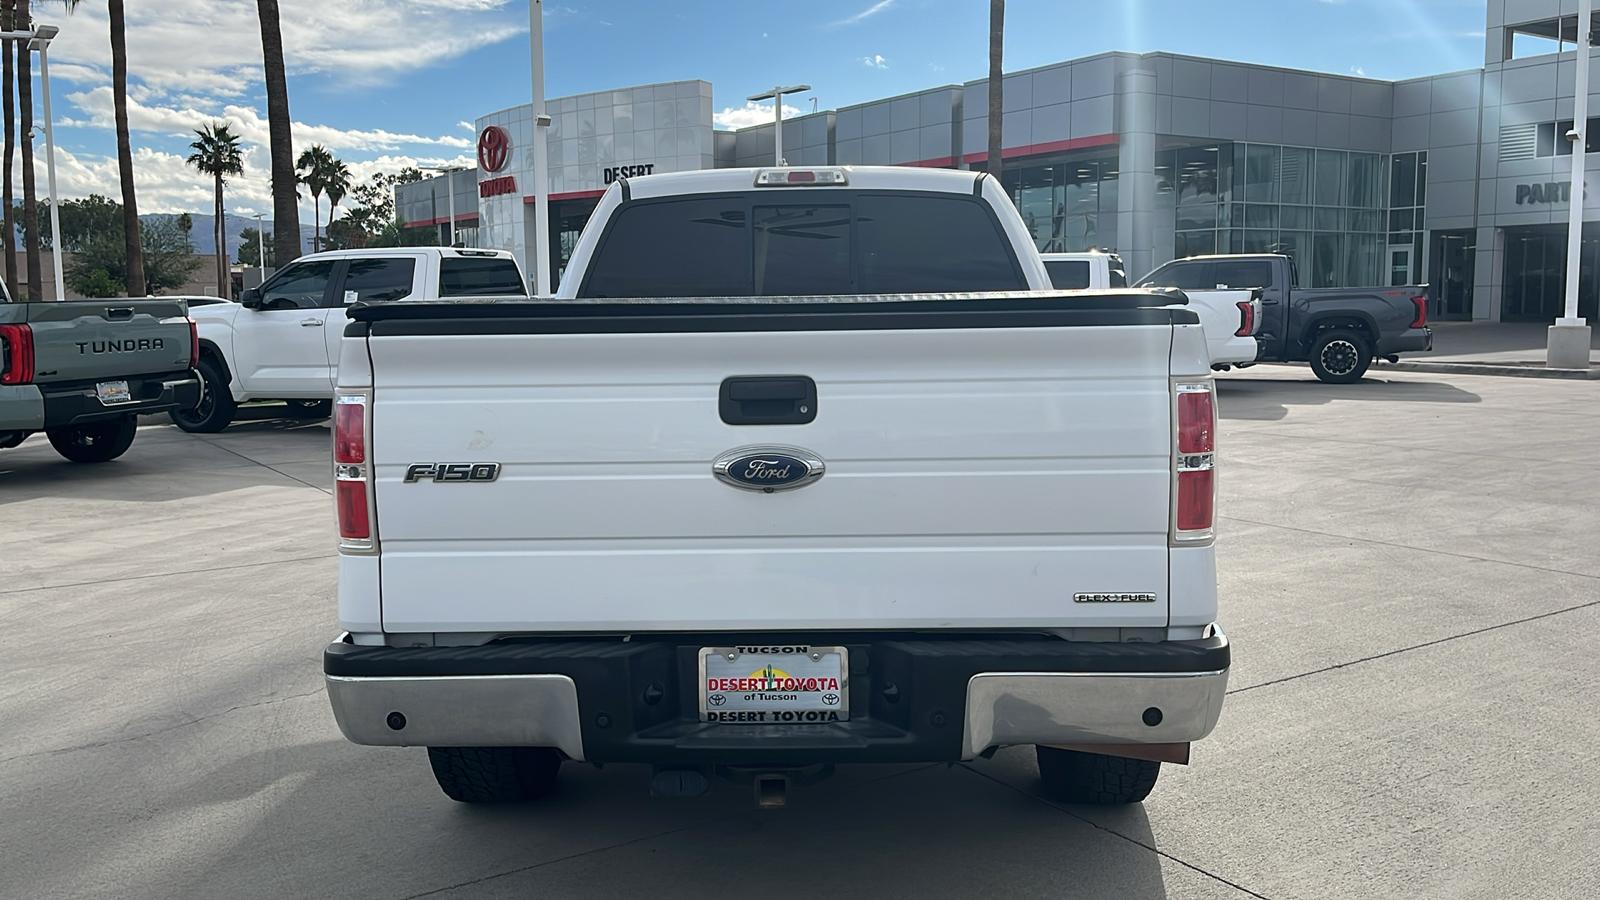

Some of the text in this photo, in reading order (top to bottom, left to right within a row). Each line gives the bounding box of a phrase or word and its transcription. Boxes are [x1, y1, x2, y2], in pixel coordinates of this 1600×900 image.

[603, 164, 654, 184] DESERT
[478, 176, 516, 198] TOYOTA
[75, 338, 164, 355] TUNDRA
[403, 462, 502, 483] F-150
[744, 459, 791, 479] Ford
[1078, 594, 1111, 602] FLEX
[737, 646, 808, 654] TUCSON
[708, 677, 839, 691] DESERT TOYOTA
[743, 692, 798, 701] of Tucson
[707, 711, 840, 722] DESERT TOYOTA
